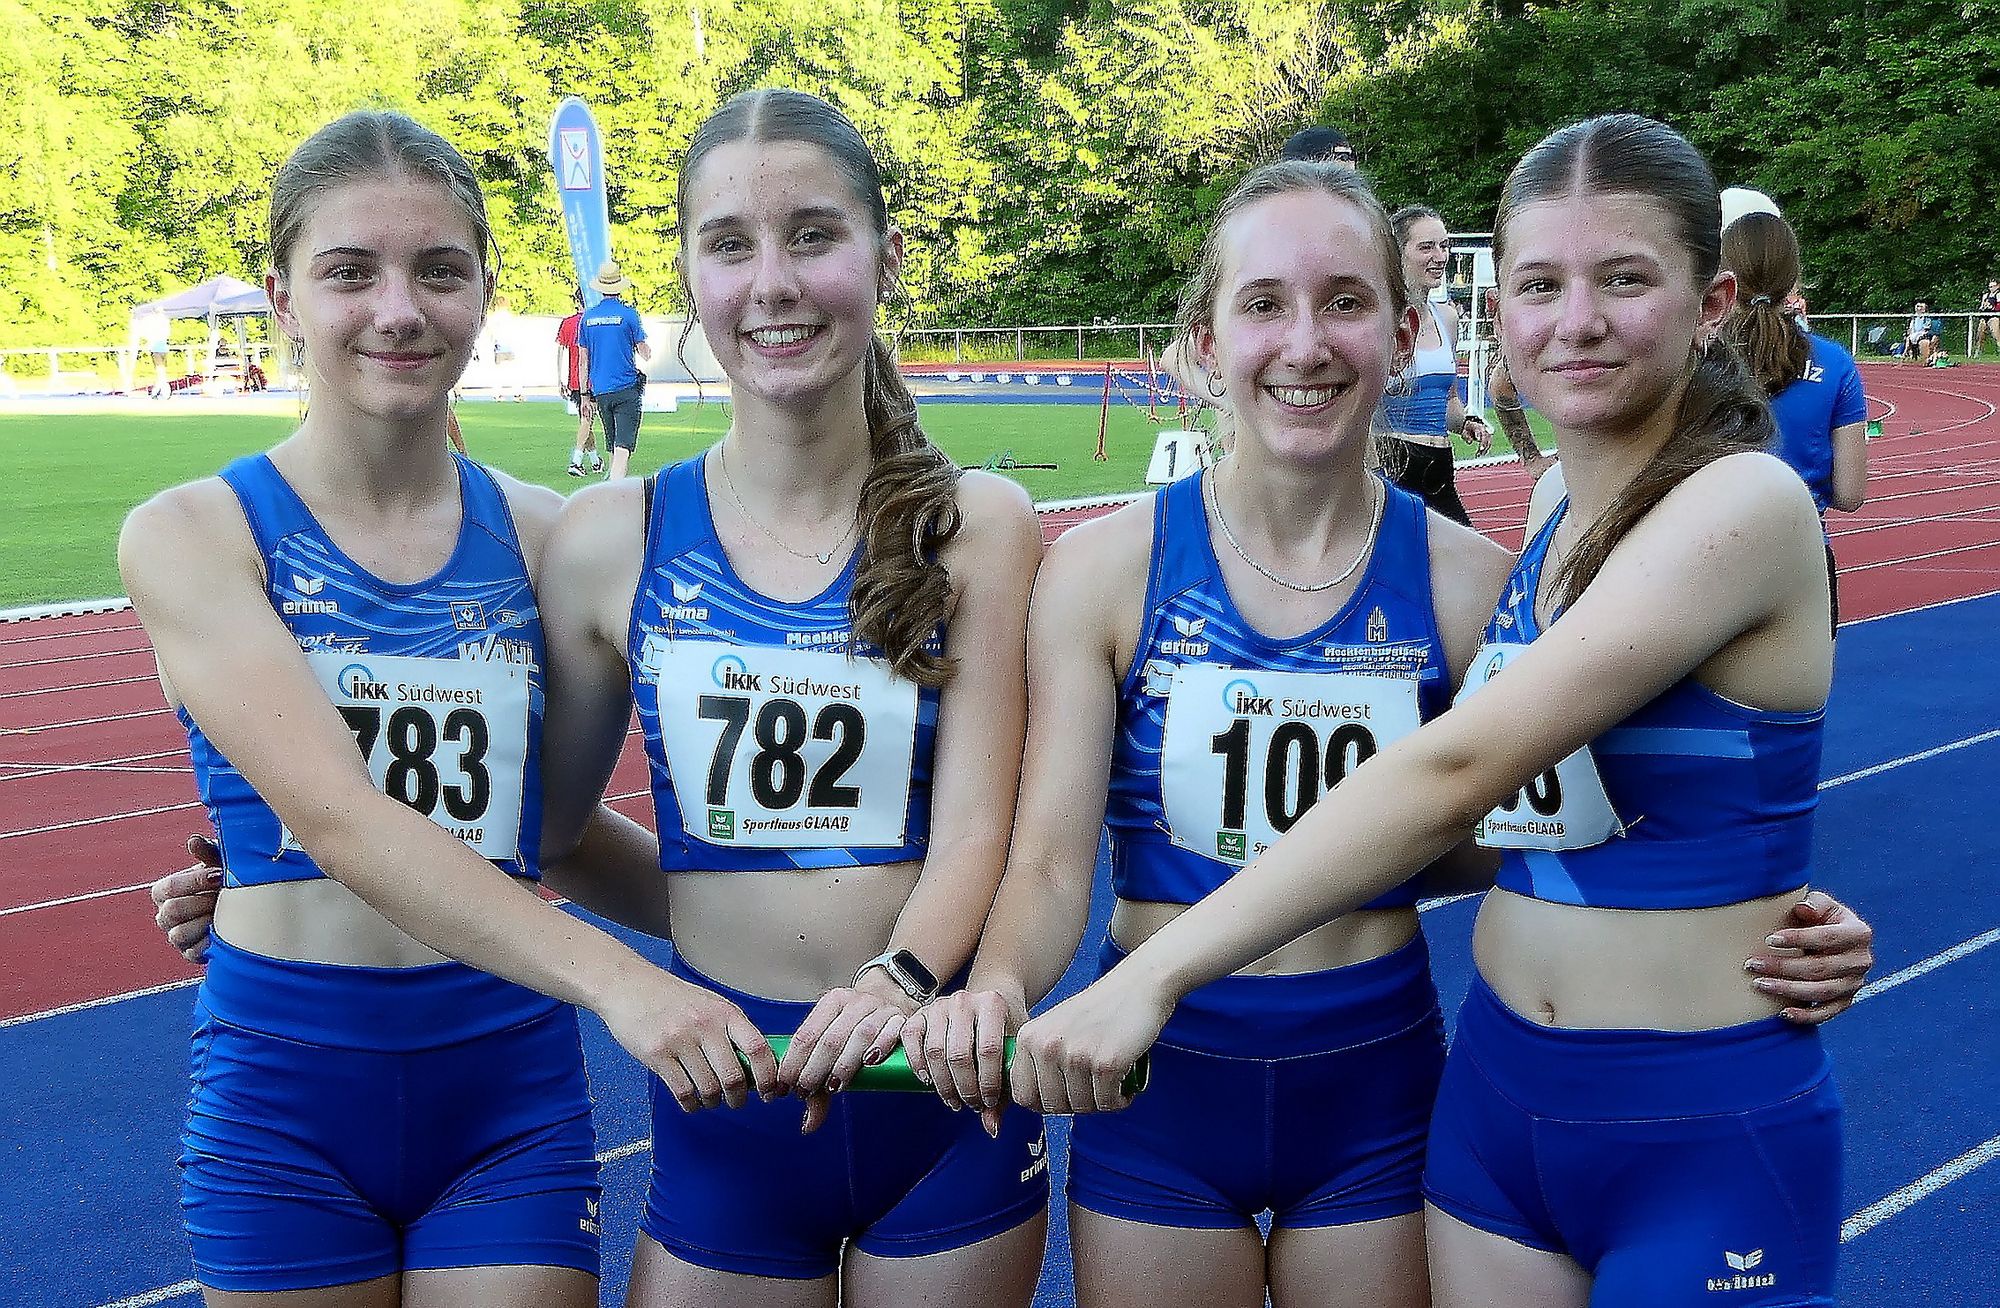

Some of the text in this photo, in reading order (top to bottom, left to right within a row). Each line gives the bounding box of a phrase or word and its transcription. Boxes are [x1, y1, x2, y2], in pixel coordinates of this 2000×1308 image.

[1164, 441, 1177, 477] 1
[282, 599, 338, 614] erima
[661, 606, 708, 620] erima
[1160, 639, 1209, 656] erima
[397, 684, 482, 704] Südwest
[769, 675, 861, 701] Südwest
[1281, 698, 1370, 719] Südwest
[698, 696, 866, 809] 782
[743, 816, 849, 834] Sporthaus GLAAB
[1488, 820, 1565, 835] Sporthaus GLAAB
